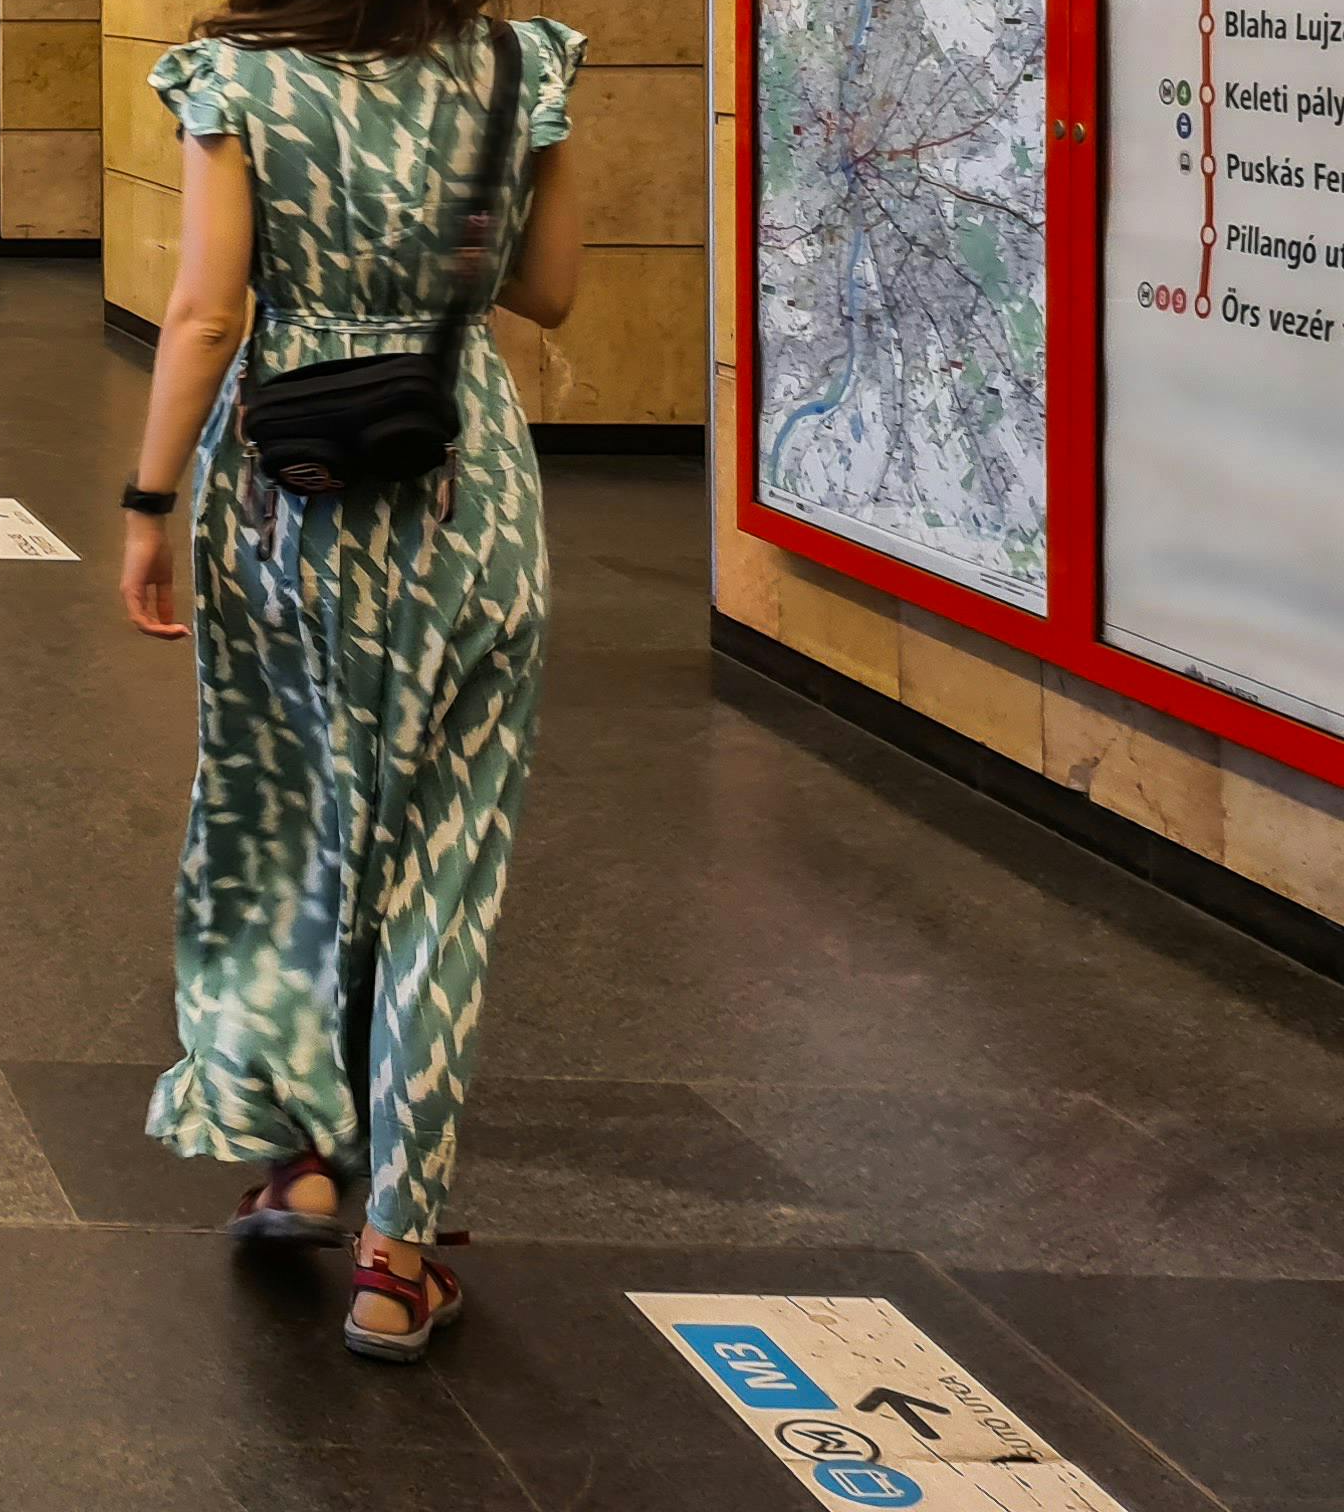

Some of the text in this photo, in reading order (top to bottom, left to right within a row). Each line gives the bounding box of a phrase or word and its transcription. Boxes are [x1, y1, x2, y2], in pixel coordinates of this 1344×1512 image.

[1225, 10, 1344, 50] Blaha Lujz
[1224, 81, 1288, 114] Keleti
[1226, 153, 1305, 189] Puskás
[1226, 224, 1317, 270] Pillangó
[1268, 309, 1335, 342] vezér
[713, 1341, 797, 1390] M3
[938, 1374, 994, 1414] UTCA
